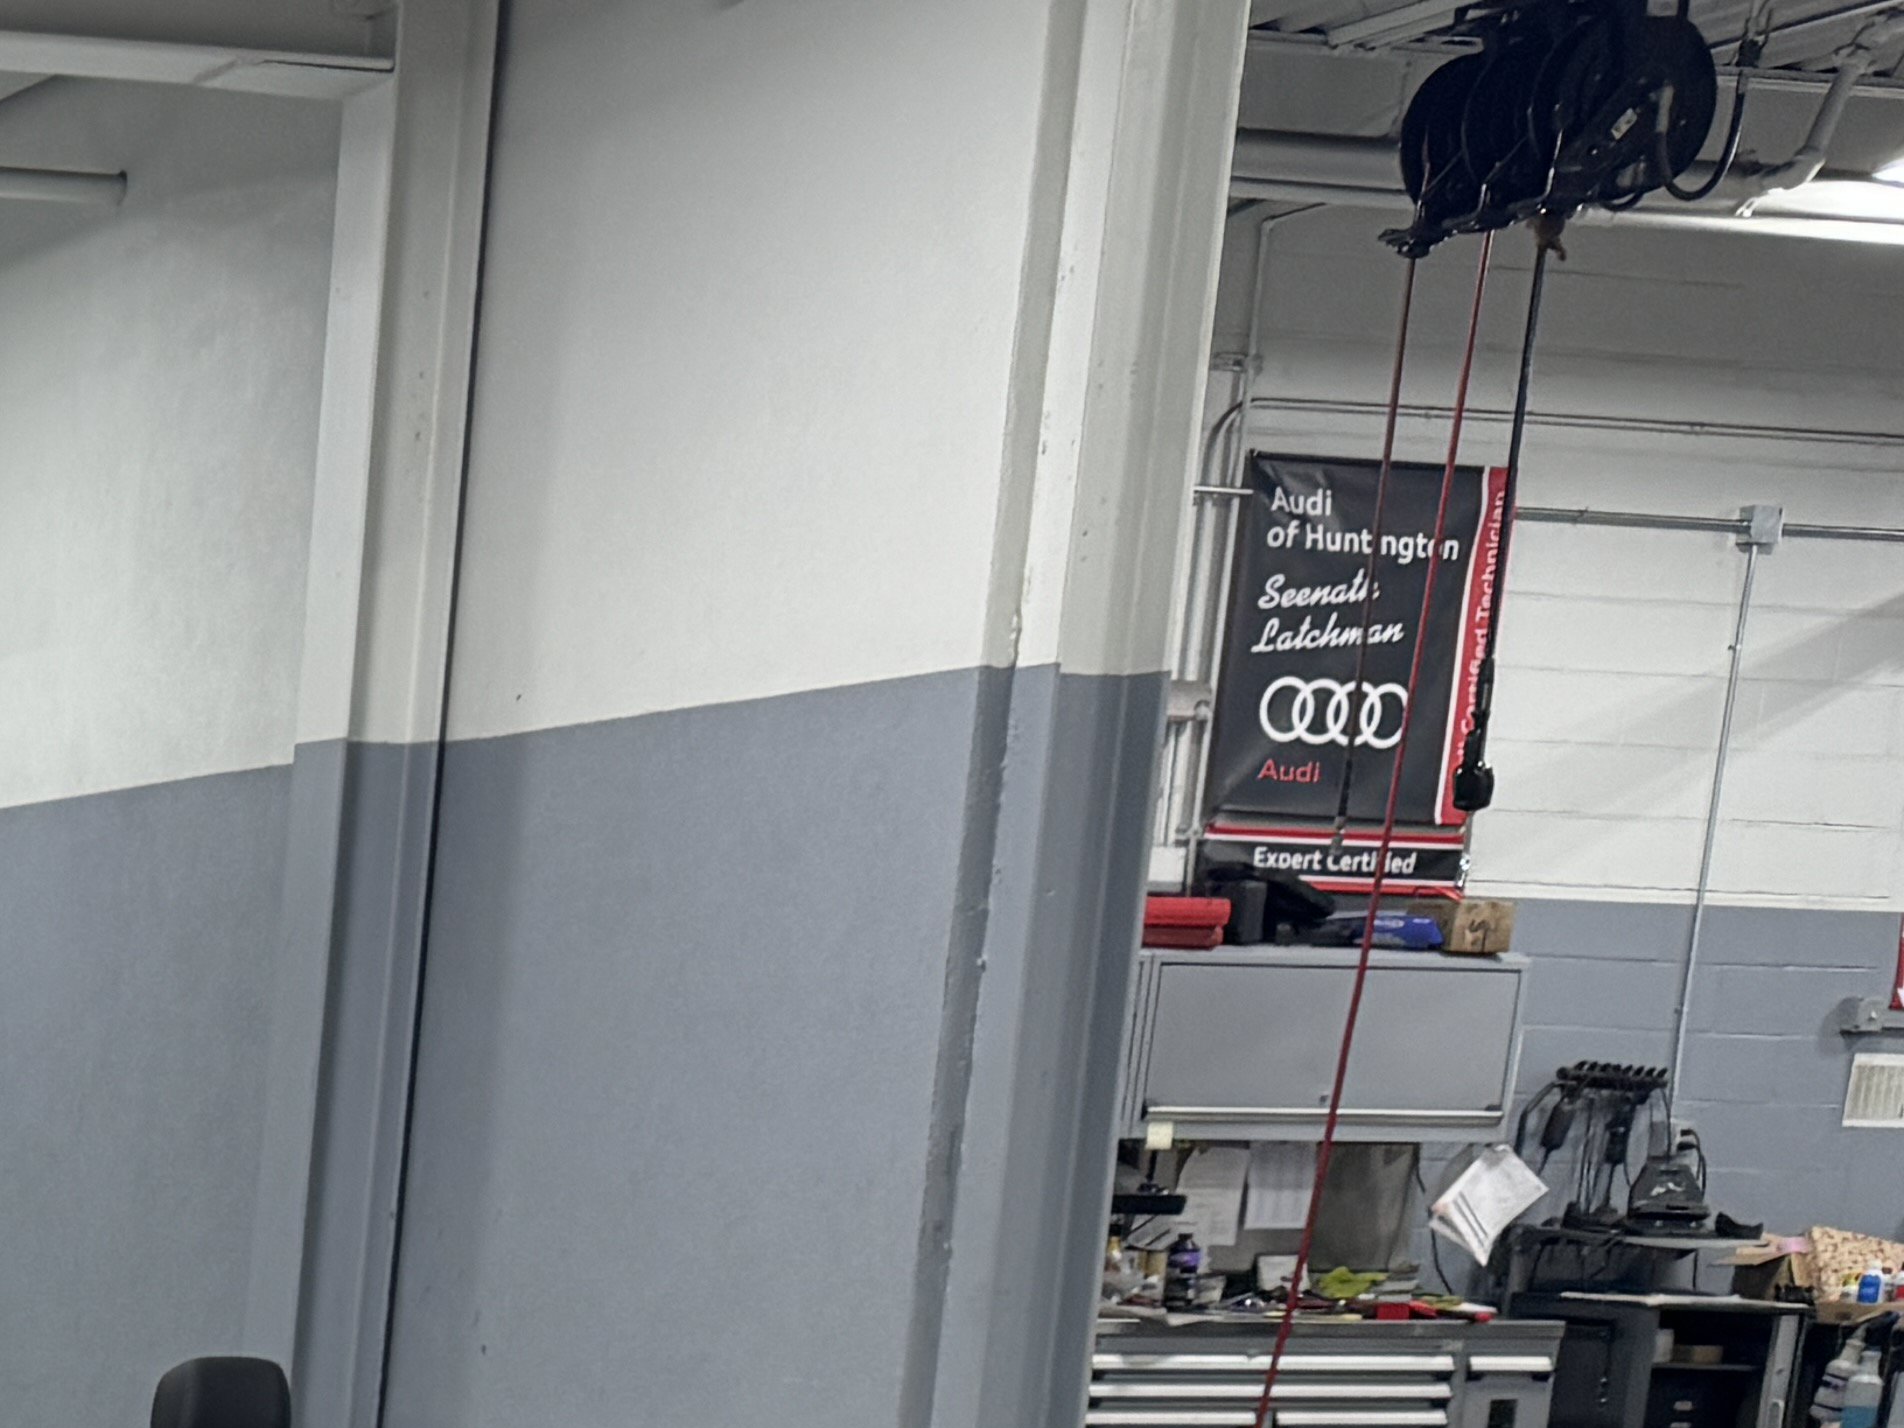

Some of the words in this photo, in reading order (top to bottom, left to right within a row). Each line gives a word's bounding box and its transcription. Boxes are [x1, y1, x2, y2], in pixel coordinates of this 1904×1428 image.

[1270, 486, 1333, 516] Audi
[1266, 519, 1301, 549] of
[1305, 523, 1459, 565] Huntngtn
[1250, 611, 1405, 654] Latchman
[1256, 758, 1321, 784] Audi
[1253, 846, 1323, 871] Expert
[1326, 851, 1418, 875] Certiied
